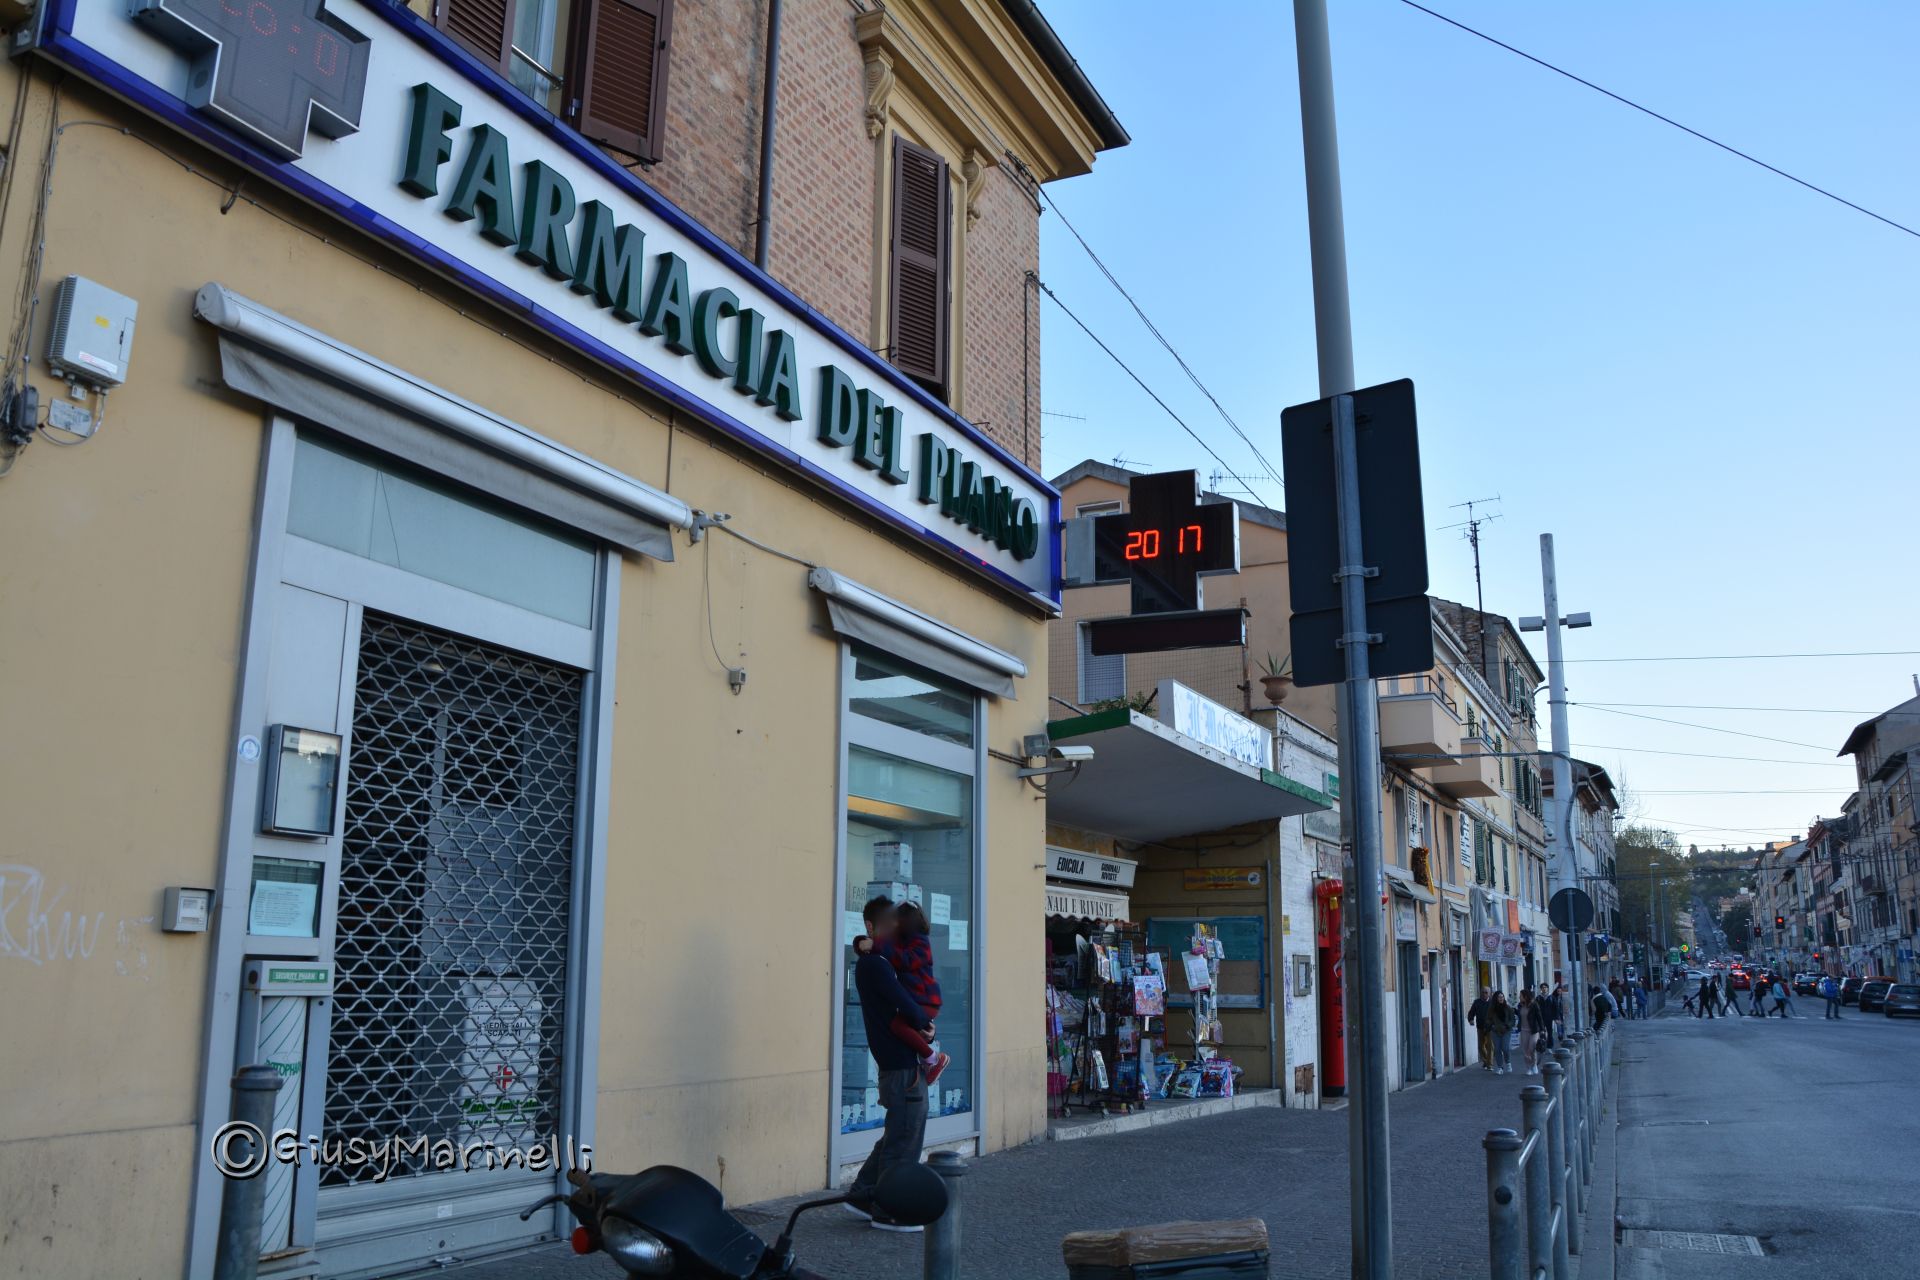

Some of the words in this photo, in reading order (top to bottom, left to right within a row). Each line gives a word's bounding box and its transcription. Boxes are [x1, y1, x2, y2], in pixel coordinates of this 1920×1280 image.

[398, 82, 803, 422] FARMACIA
[818, 364, 910, 486] DEL
[919, 432, 1039, 561] PIANO
[1125, 529, 1160, 560] 20
[1178, 525, 1202, 554] 17
[1056, 856, 1085, 875] EDICOLA
[1045, 895, 1068, 913] NALI
[1071, 898, 1077, 914] E
[1079, 899, 1114, 918] RIVISTE
